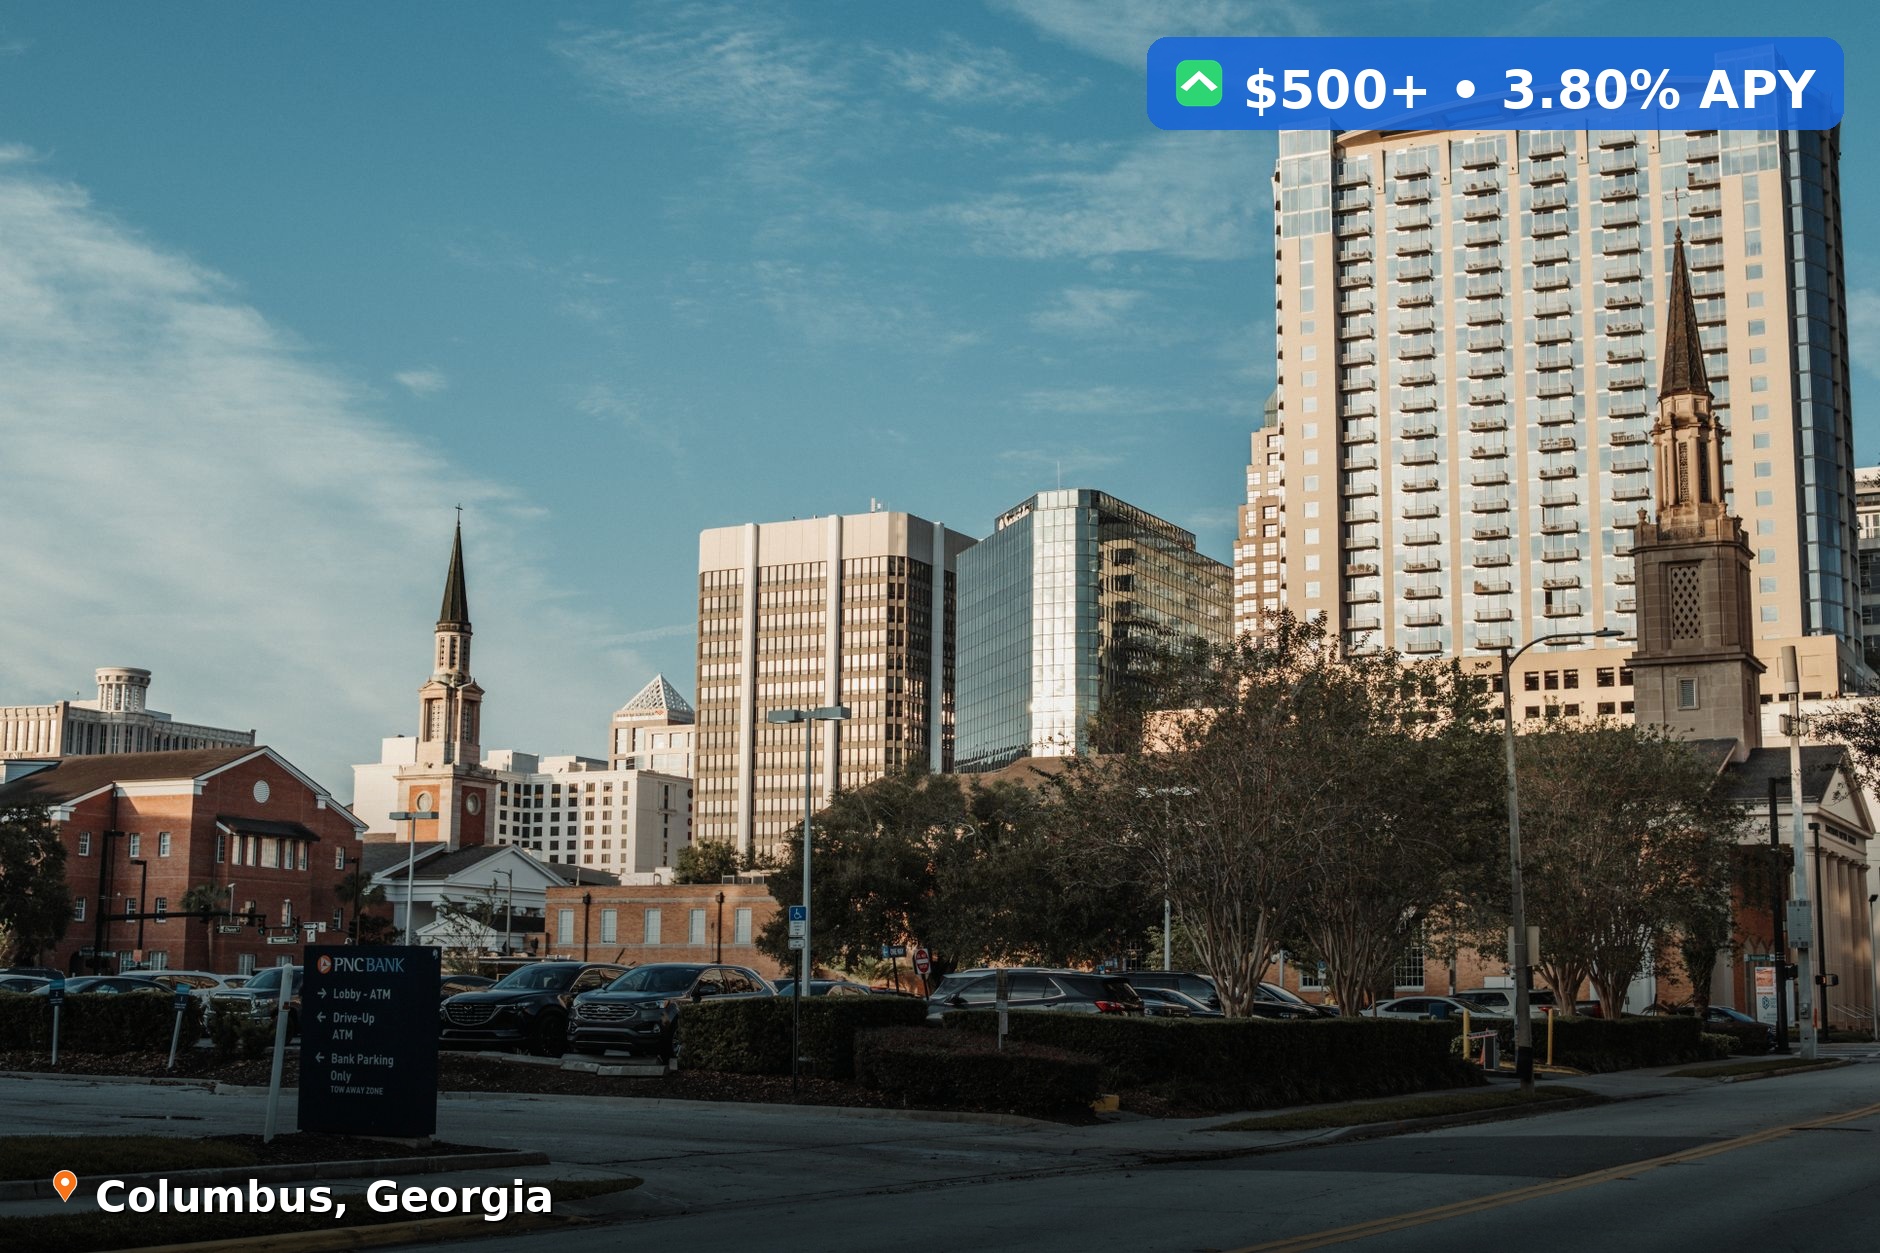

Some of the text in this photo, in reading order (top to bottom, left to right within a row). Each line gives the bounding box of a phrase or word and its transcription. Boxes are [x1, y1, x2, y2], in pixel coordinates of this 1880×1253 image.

[333, 988, 362, 1002] Lobby
[370, 988, 391, 1000] ATM
[333, 1011, 375, 1026] Drive-Up
[332, 1029, 353, 1041] ATM
[331, 1053, 394, 1069] Bank Parking
[330, 1070, 352, 1084] Only
[330, 1085, 384, 1096] TOW AWAY ZONE
